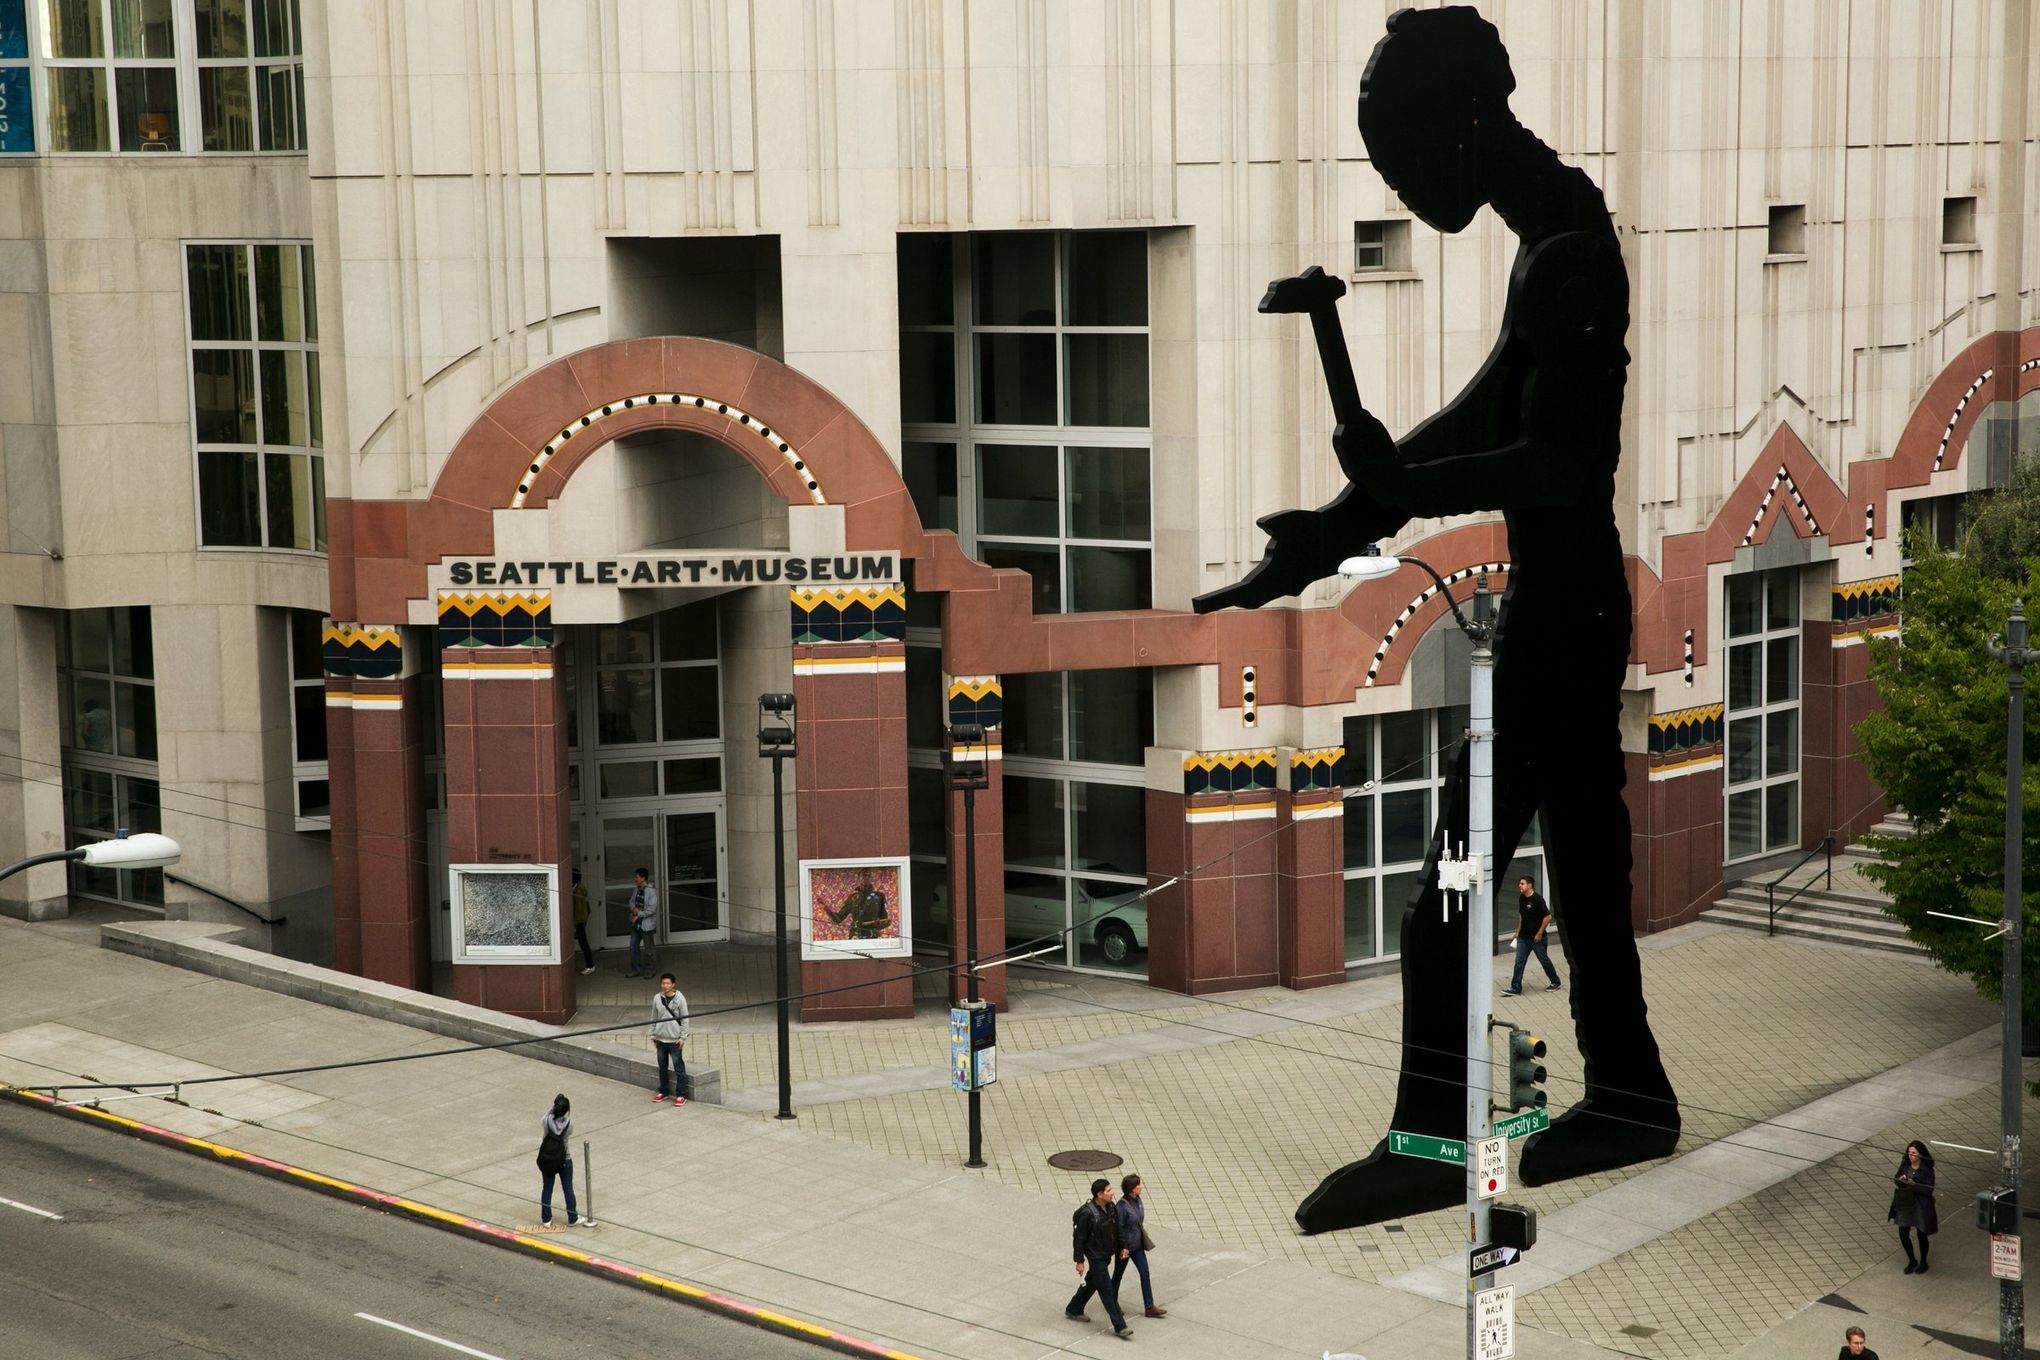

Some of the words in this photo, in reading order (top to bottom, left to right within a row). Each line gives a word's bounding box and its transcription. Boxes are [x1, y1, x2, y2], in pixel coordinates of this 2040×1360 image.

[1532, 1116, 1540, 1128] St
[1396, 1134, 1409, 1150] 1st
[1440, 1143, 1459, 1157] Ave
[1485, 1142, 1499, 1154] NO
[1484, 1156, 1502, 1167] TURN
[1480, 1169, 1489, 1179] ON
[1492, 1166, 1504, 1176] RED
[1996, 1244, 2016, 1256] 2-7AM
[1475, 1254, 1488, 1268] ONE
[1490, 1248, 1505, 1262] WAY
[1480, 1296, 1493, 1304] ALL
[1493, 1290, 1509, 1302] WAY
[1486, 1304, 1504, 1315] WALK
